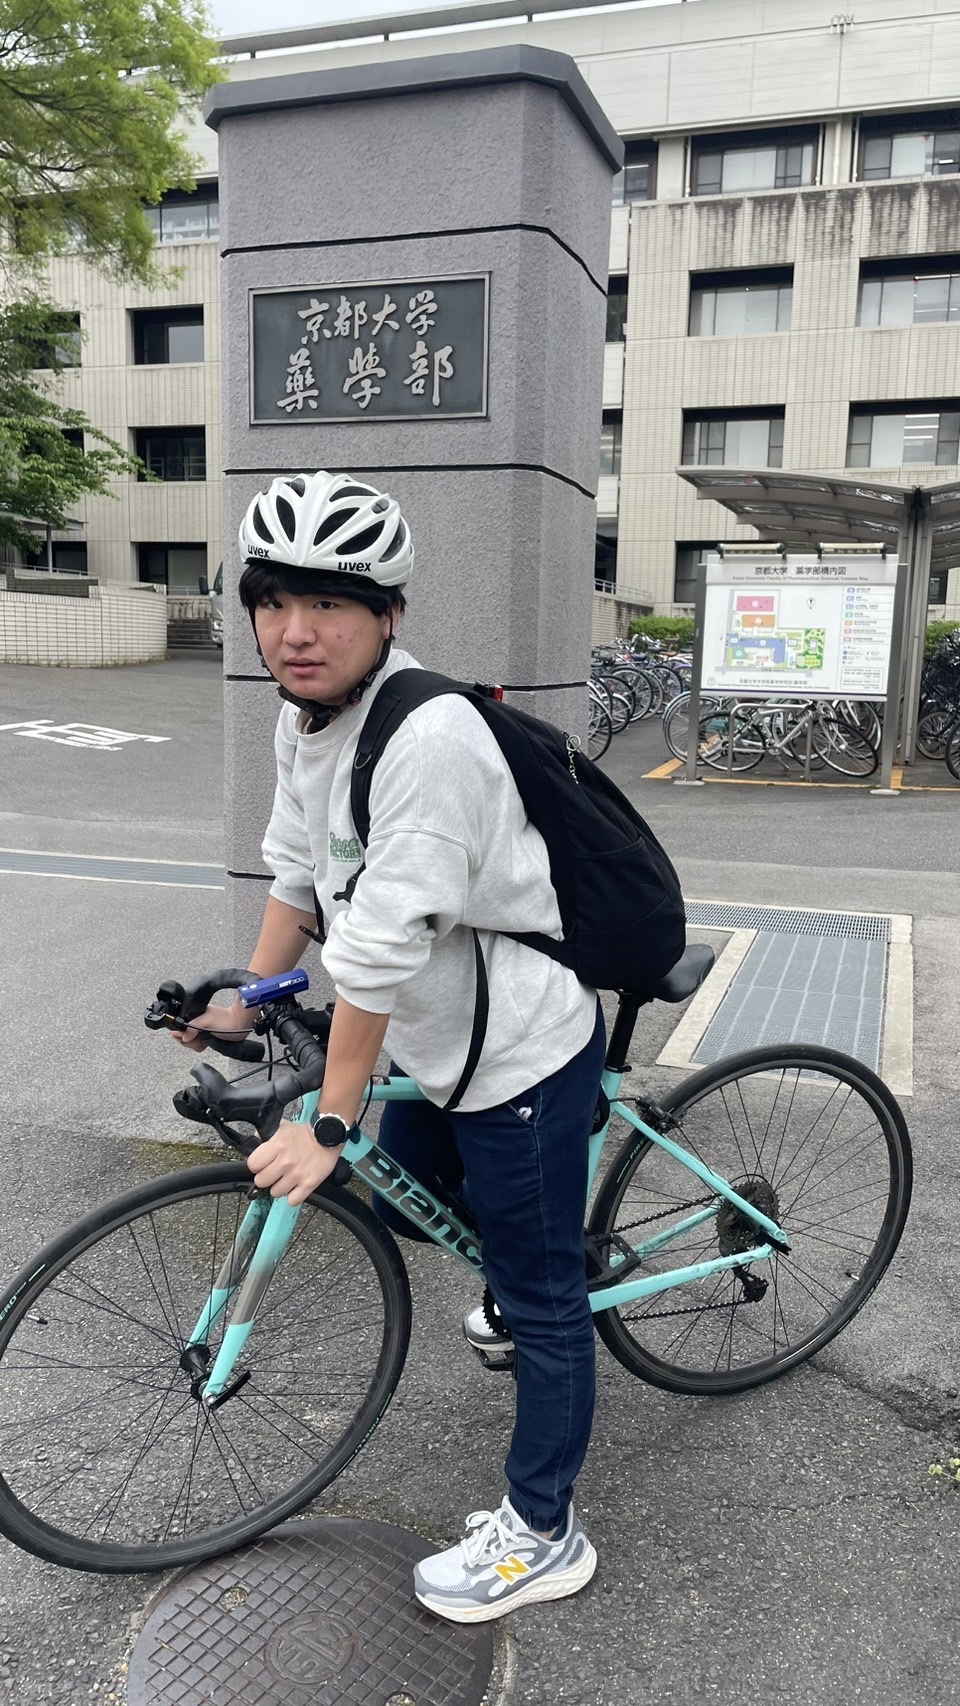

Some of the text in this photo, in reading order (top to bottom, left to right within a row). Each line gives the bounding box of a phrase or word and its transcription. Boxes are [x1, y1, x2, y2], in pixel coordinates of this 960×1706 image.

[298, 290, 438, 344] 京都大学
[247, 544, 270, 559] uvex
[337, 561, 371, 572] uvex
[754, 567, 788, 575] 京都大学
[352, 1145, 483, 1267] Bianc
[490, 1553, 532, 1585] N
